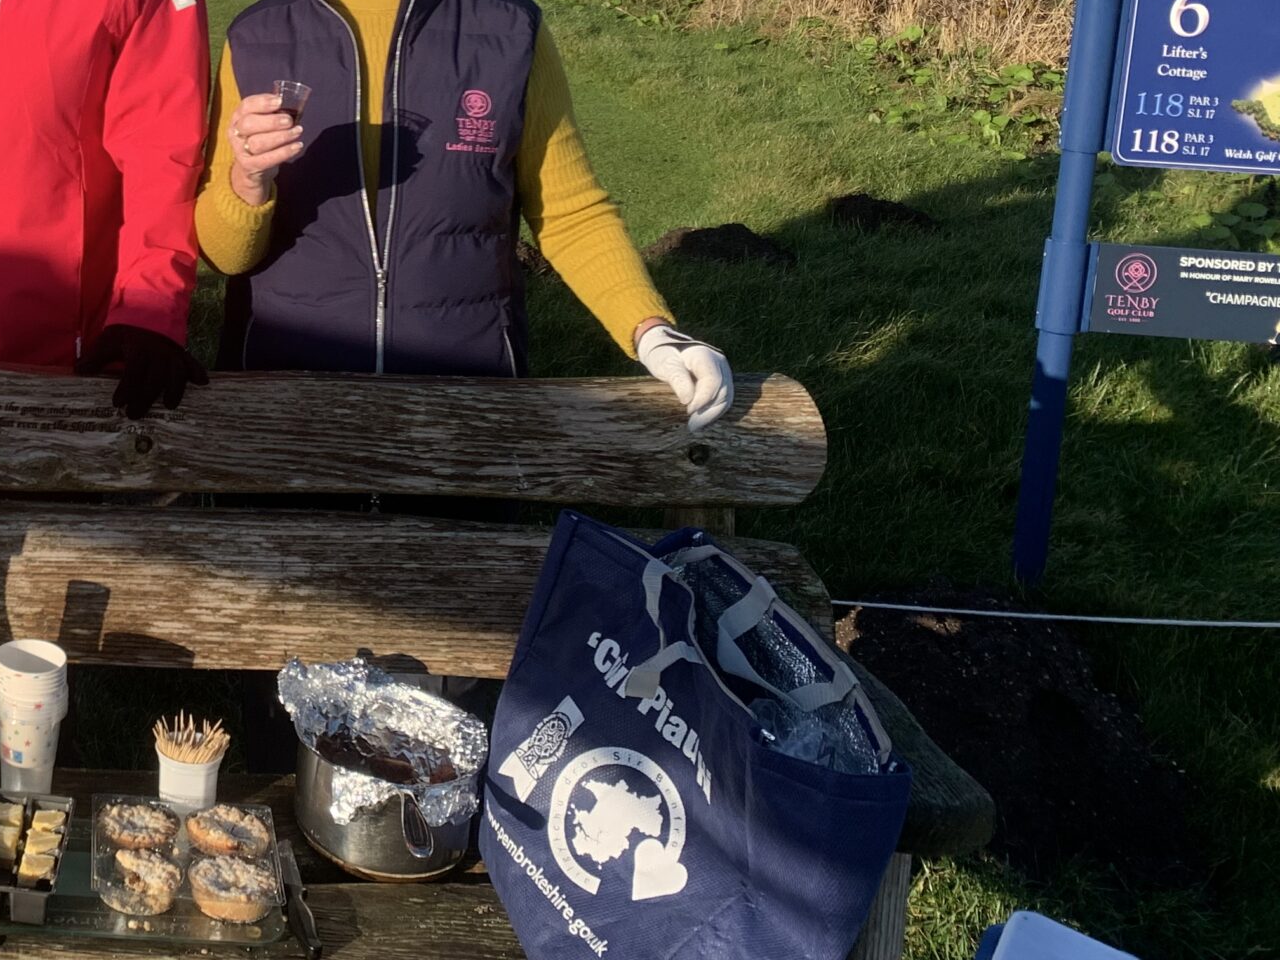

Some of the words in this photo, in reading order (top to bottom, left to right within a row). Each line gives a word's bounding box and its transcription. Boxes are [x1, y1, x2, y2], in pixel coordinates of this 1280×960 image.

[1161, 44, 1208, 60] Lifter's
[1156, 63, 1208, 81] Cottage
[1135, 91, 1184, 117] 118
[1189, 95, 1210, 105] PAR
[1212, 96, 1219, 107] 3
[1205, 109, 1216, 119] 17
[1130, 128, 1180, 154] 118
[1184, 133, 1206, 143] PAR
[1207, 134, 1214, 144] 3
[1200, 146, 1211, 157] 17
[1224, 148, 1253, 160] Welsh
[1255, 150, 1278, 163] Golf
[1179, 256, 1256, 272] SPONSORED
[1257, 261, 1276, 273] BY
[1189, 272, 1221, 281] HONOUR
[1233, 275, 1254, 283] MARY
[1104, 294, 1161, 310] TENBY
[1107, 308, 1130, 316] GOLF
[1131, 310, 1155, 318] CLUB
[612, 751, 643, 767] Sir
